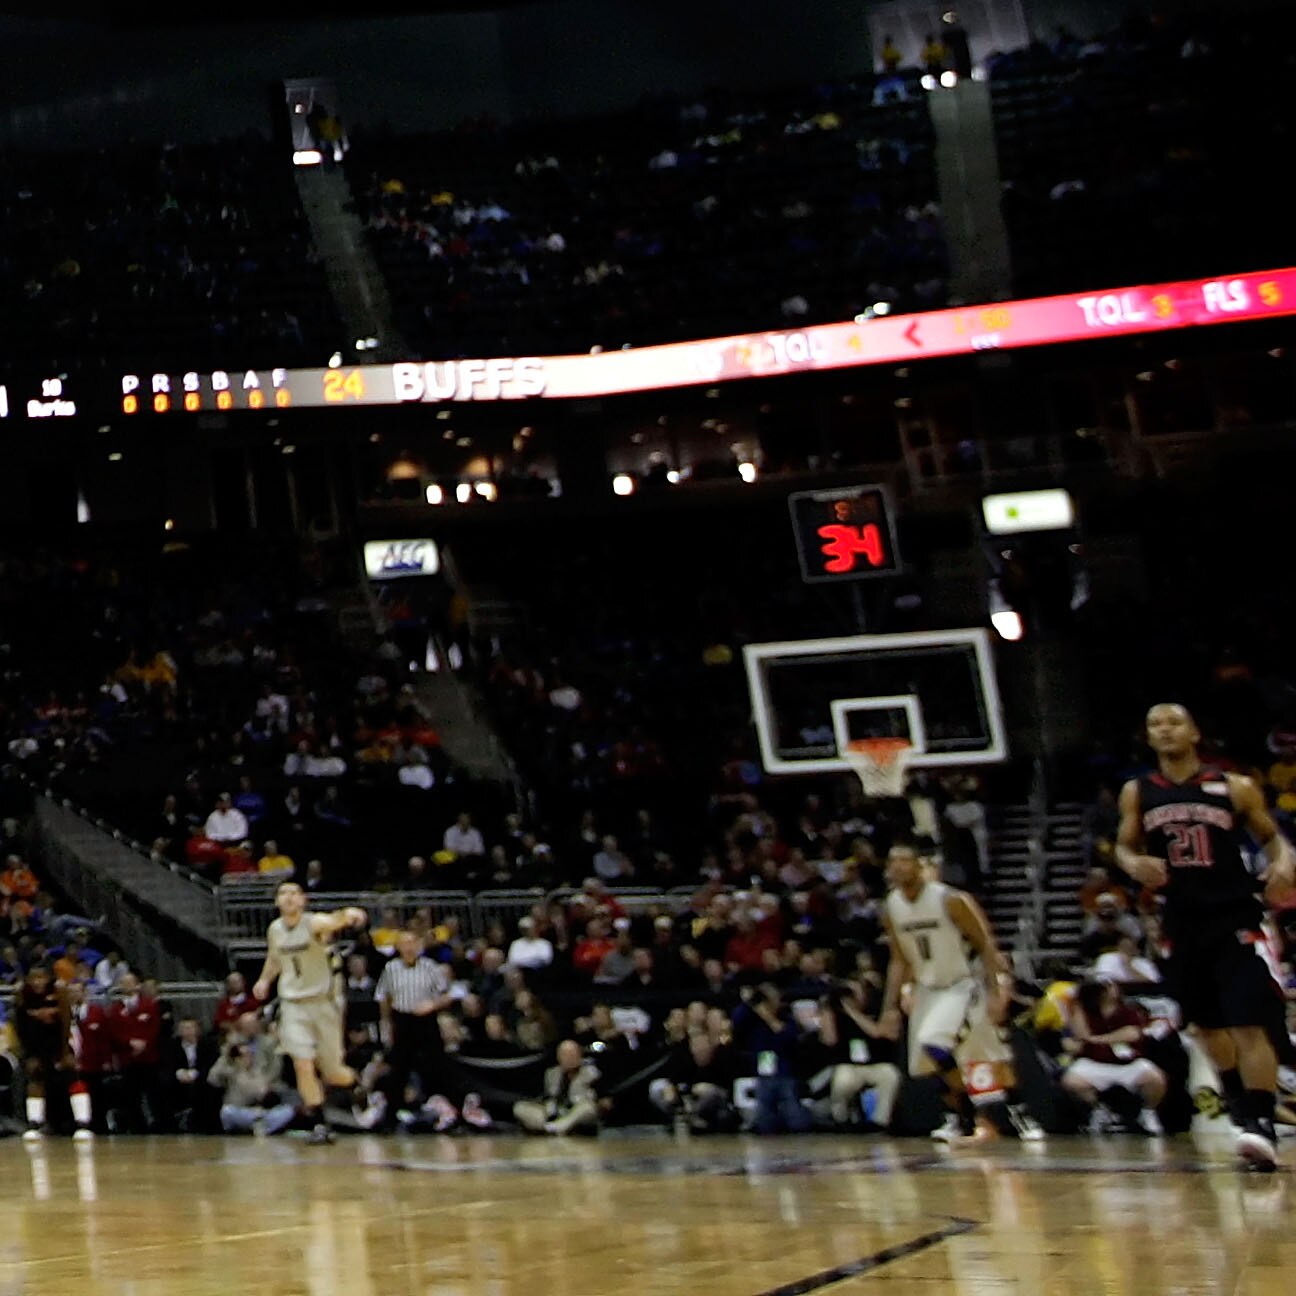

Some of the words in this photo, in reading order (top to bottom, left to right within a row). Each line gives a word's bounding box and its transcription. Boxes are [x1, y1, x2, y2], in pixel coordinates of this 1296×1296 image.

[122, 374, 139, 394] P
[152, 373, 170, 393] R
[184, 372, 200, 392] S
[243, 369, 260, 389] A
[272, 368, 287, 388] F
[322, 368, 365, 402] 24
[392, 357, 547, 401] BUFFS
[817, 523, 884, 573] 34
[1162, 823, 1214, 868] 21
